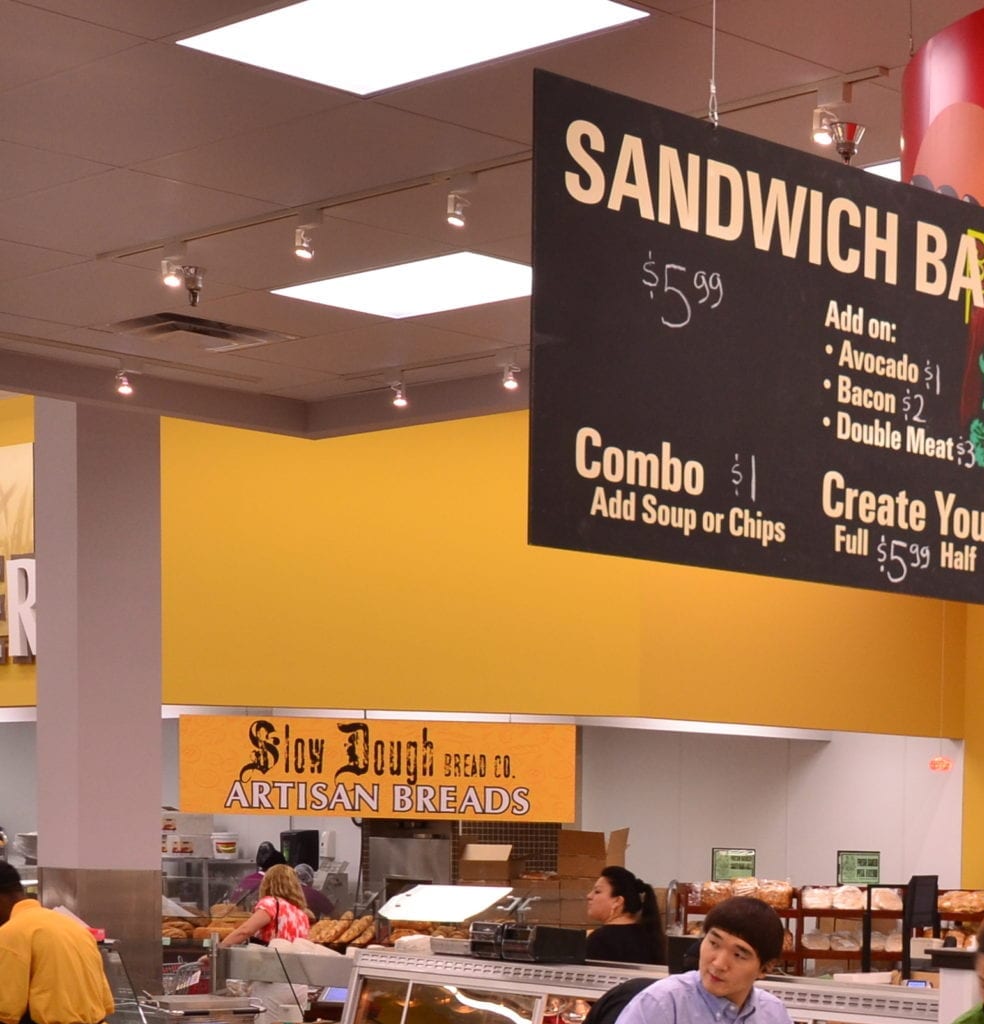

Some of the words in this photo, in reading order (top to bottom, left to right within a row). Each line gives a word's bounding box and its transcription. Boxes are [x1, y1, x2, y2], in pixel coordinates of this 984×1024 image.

[565, 119, 898, 286] SANDWICH
[825, 300, 864, 335] Add
[868, 318, 896, 343] on:
[839, 340, 919, 383] Avocado
[838, 375, 896, 414] Bacon
[902, 388, 926, 422] $2
[837, 411, 901, 450] Double
[906, 426, 954, 460] Meat
[575, 427, 704, 495] Combo
[590, 487, 635, 531] Add
[642, 494, 696, 536] Soup
[702, 511, 724, 533] or
[729, 507, 786, 547] Chips
[822, 470, 926, 532] Create
[834, 525, 868, 556] Full
[940, 541, 977, 572] Half
[239, 720, 324, 784] Slow
[334, 722, 434, 785] Dough
[443, 753, 487, 778] BREAD
[494, 755, 516, 779] CO.
[224, 780, 380, 813] ARTISAN
[392, 783, 531, 816] BREADS
